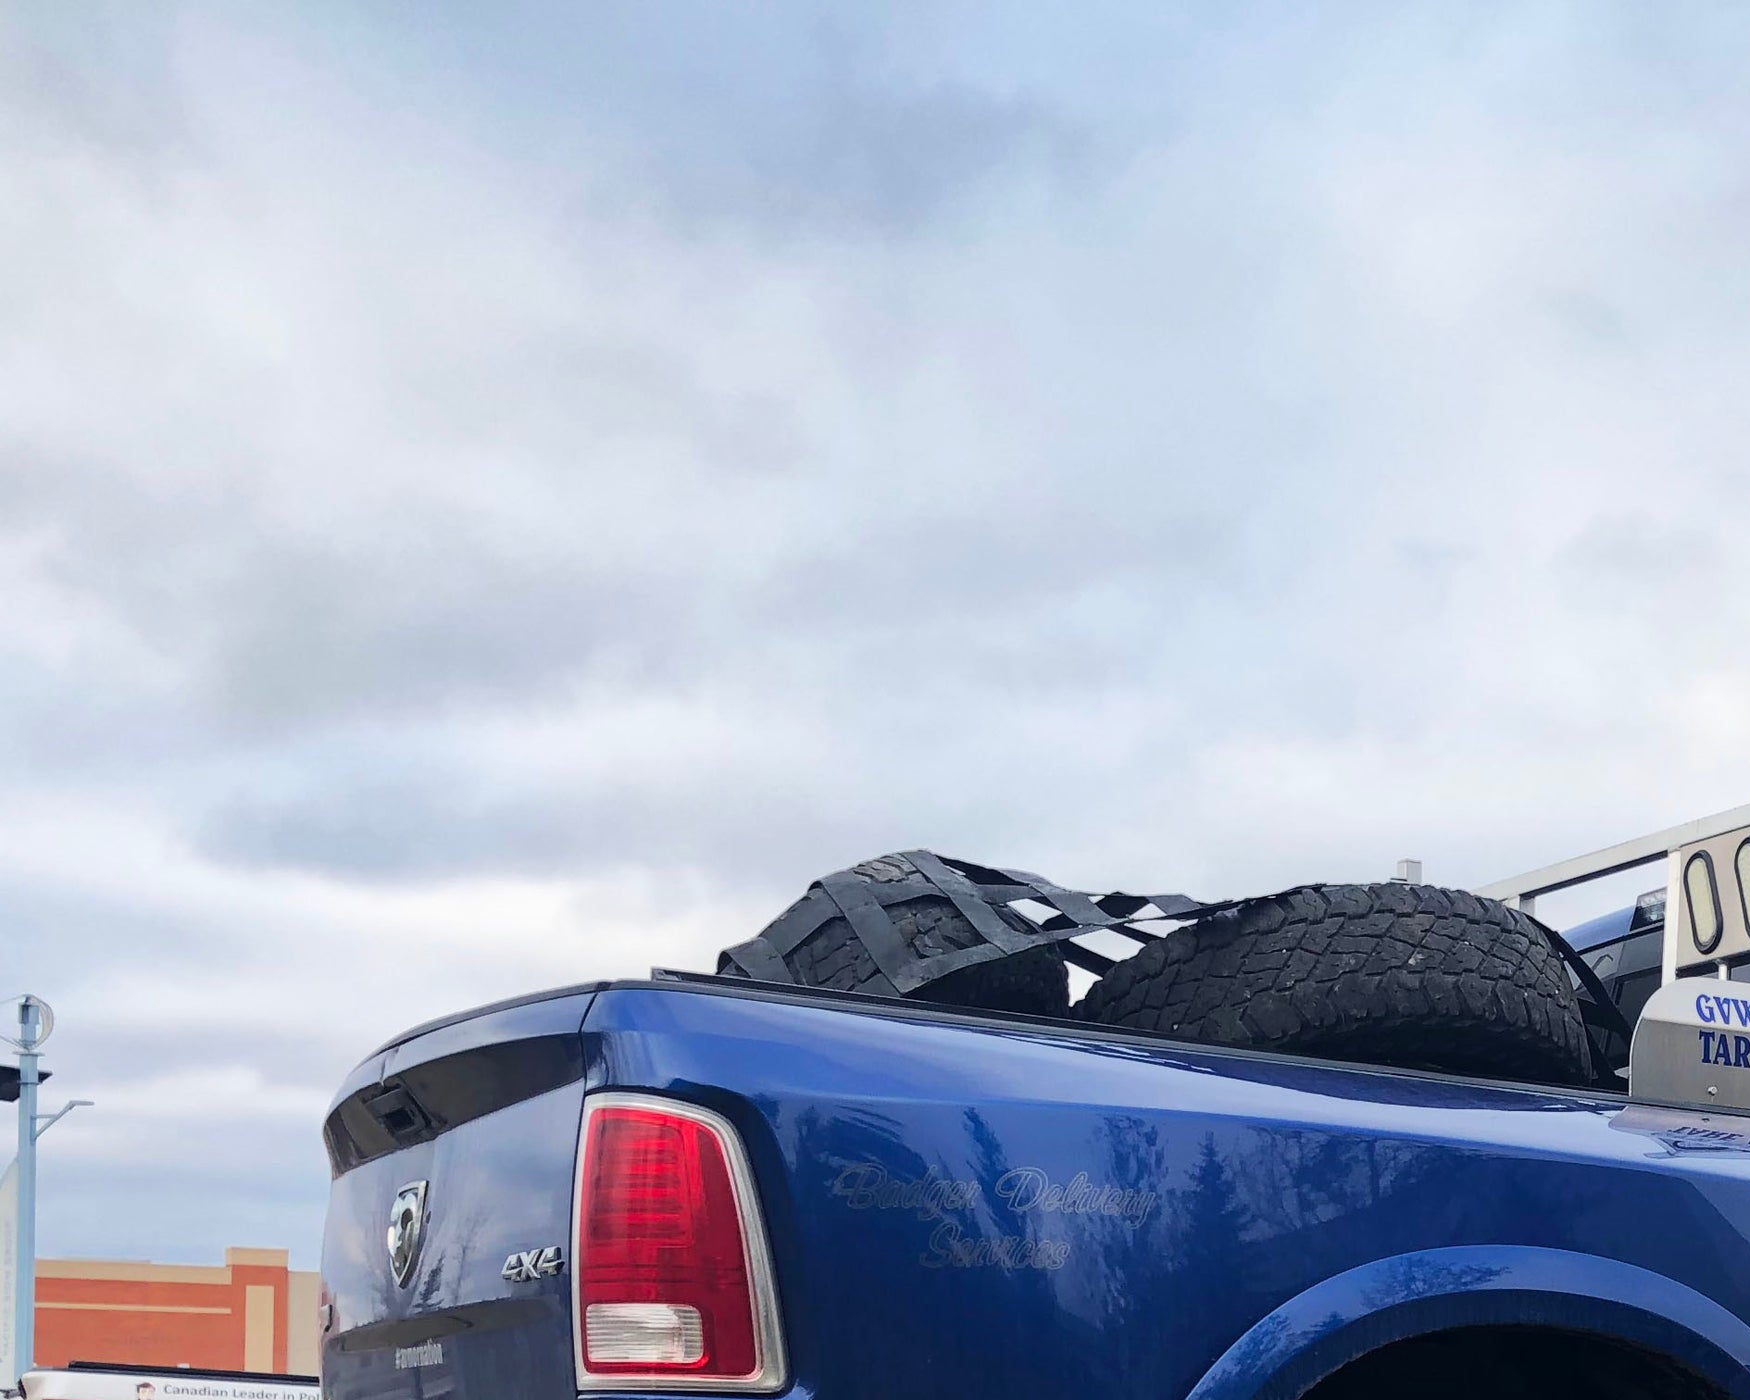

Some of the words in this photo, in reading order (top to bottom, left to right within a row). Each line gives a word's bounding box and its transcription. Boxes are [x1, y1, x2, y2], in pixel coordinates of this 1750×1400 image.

[832, 1162, 982, 1220] Badger
[995, 1166, 1156, 1229] Delivery
[920, 1221, 1070, 1269] Services
[163, 1384, 229, 1397] Canadian
[233, 1388, 278, 1400] Leader
[283, 1390, 295, 1400] in
